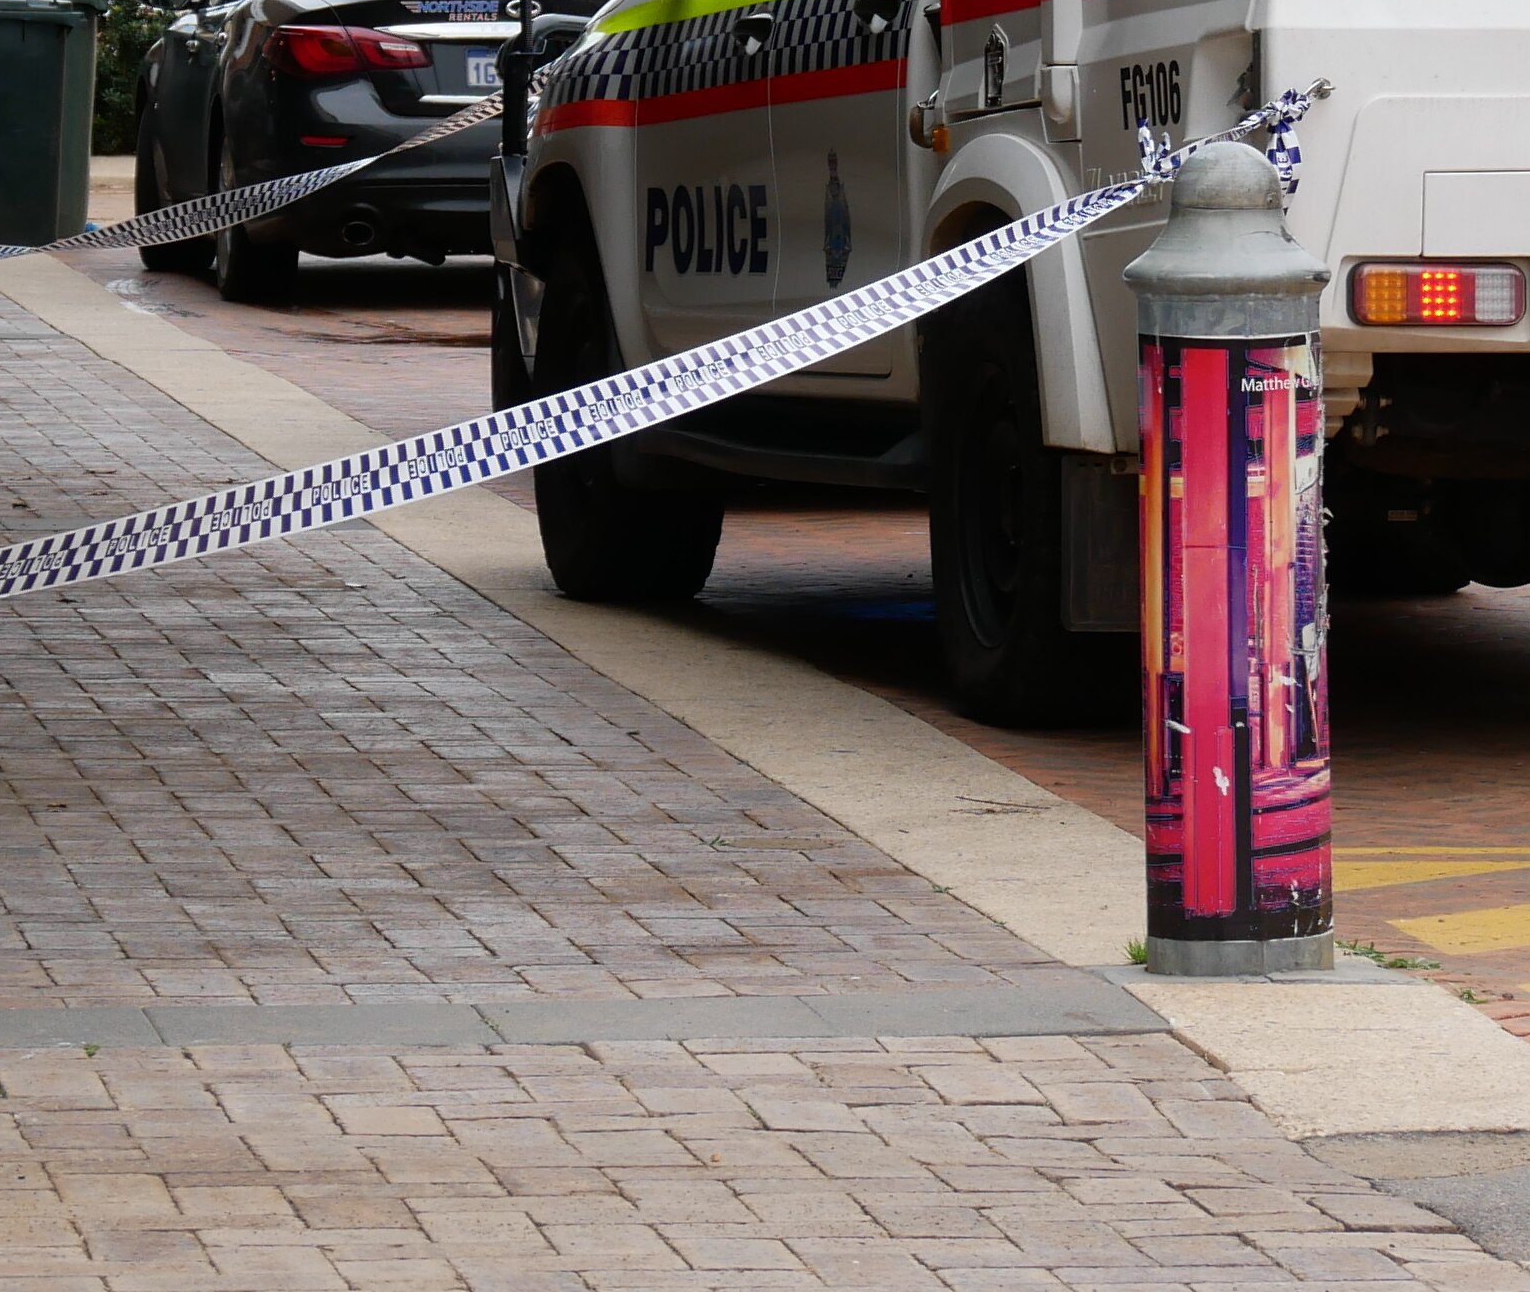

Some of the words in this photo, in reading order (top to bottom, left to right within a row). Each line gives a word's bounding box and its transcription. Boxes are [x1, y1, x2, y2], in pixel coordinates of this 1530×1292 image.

[419, 0, 500, 13] NORTHSIDE
[448, 12, 498, 21] RENTALS
[1120, 60, 1182, 130] FG106
[645, 183, 769, 275] POLICE
[837, 300, 891, 328] POLICE
[756, 332, 812, 361] POLICE
[675, 361, 729, 391] POLICE
[589, 392, 643, 423] POLICE
[500, 419, 557, 450] POLICE
[408, 447, 464, 479] POLICE
[312, 475, 371, 505] POLICE
[211, 502, 270, 531] POLICE
[106, 526, 170, 556] POLICE
[0, 551, 65, 580] POLICE
